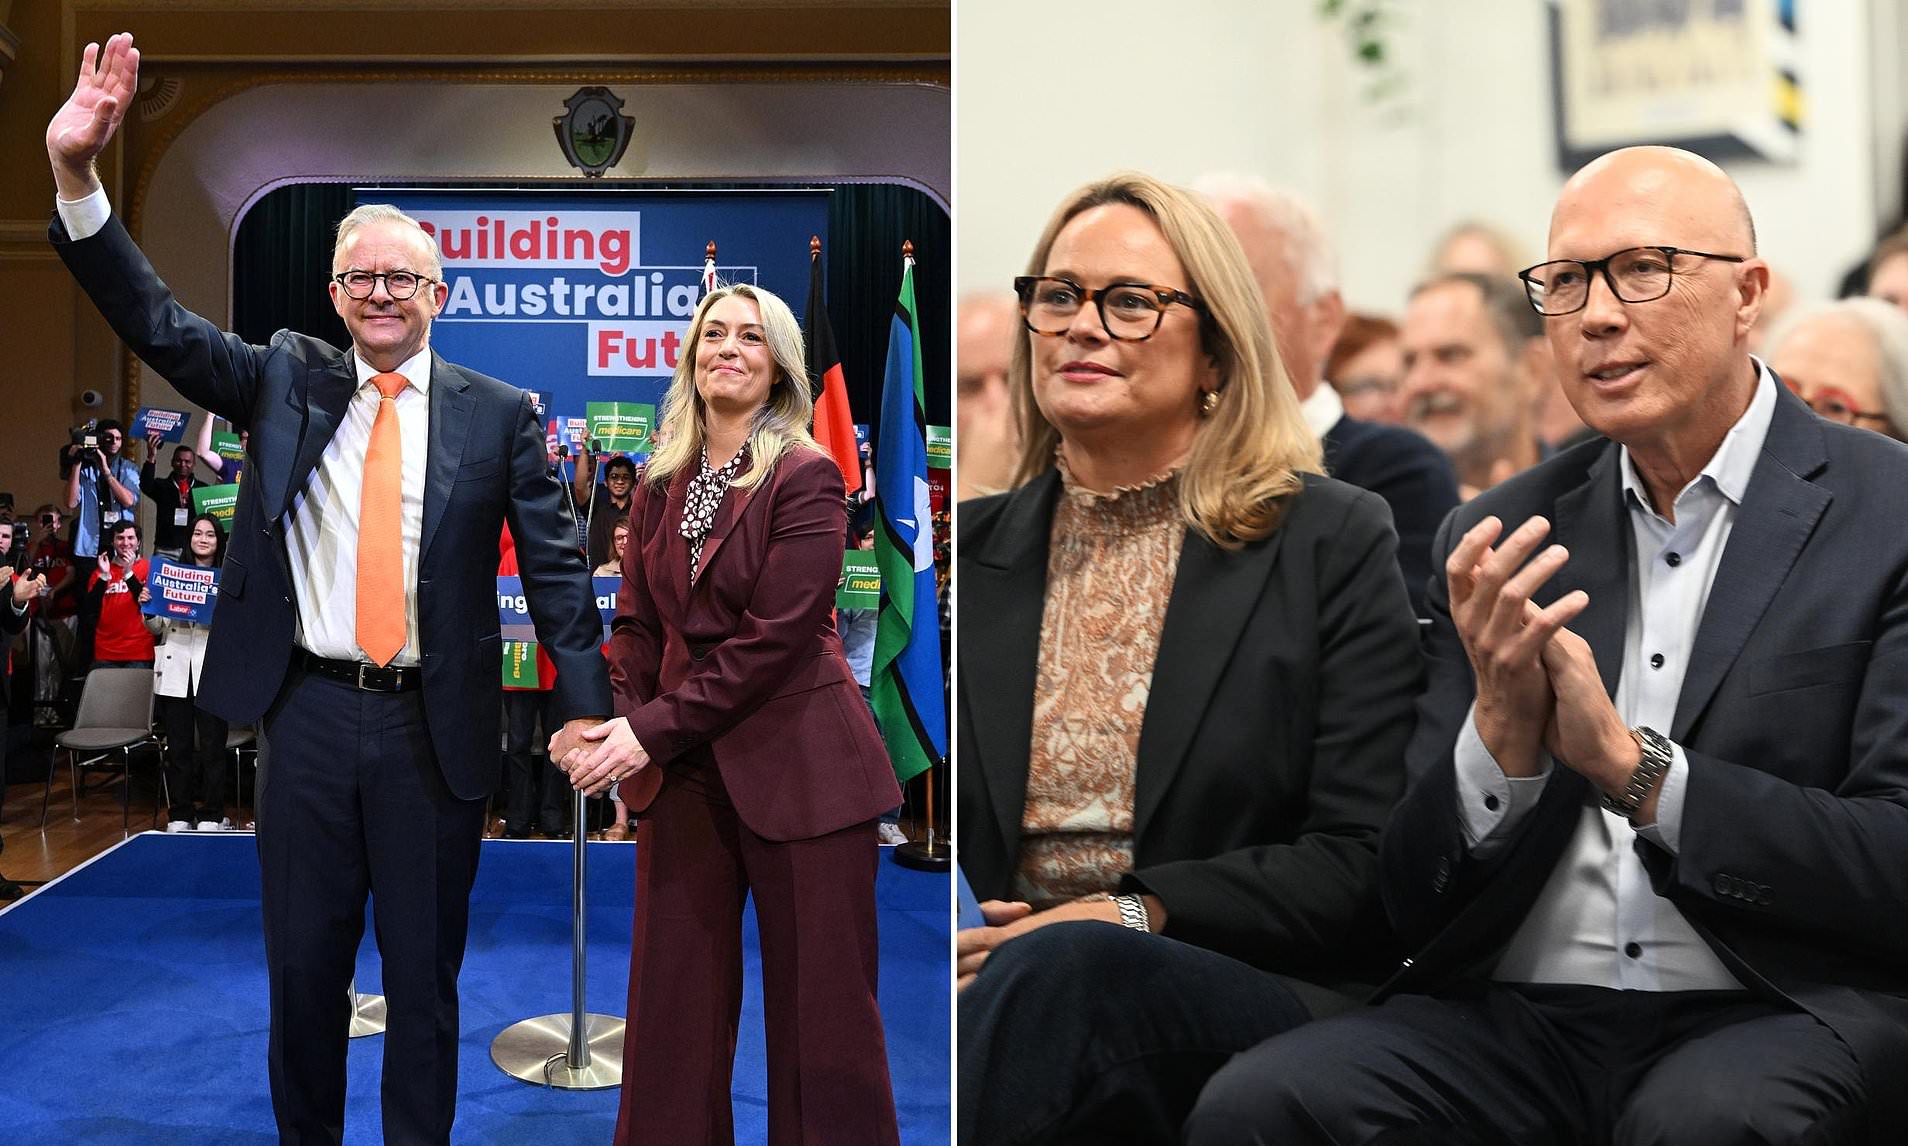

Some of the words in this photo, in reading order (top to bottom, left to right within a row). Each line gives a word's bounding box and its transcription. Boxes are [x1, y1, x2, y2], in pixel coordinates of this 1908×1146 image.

[418, 216, 631, 275] uilding
[598, 425, 641, 436] medicare
[163, 566, 211, 584] Building
[154, 576, 218, 594] Australia's
[165, 589, 204, 602] Future
[169, 604, 189, 613] Labor
